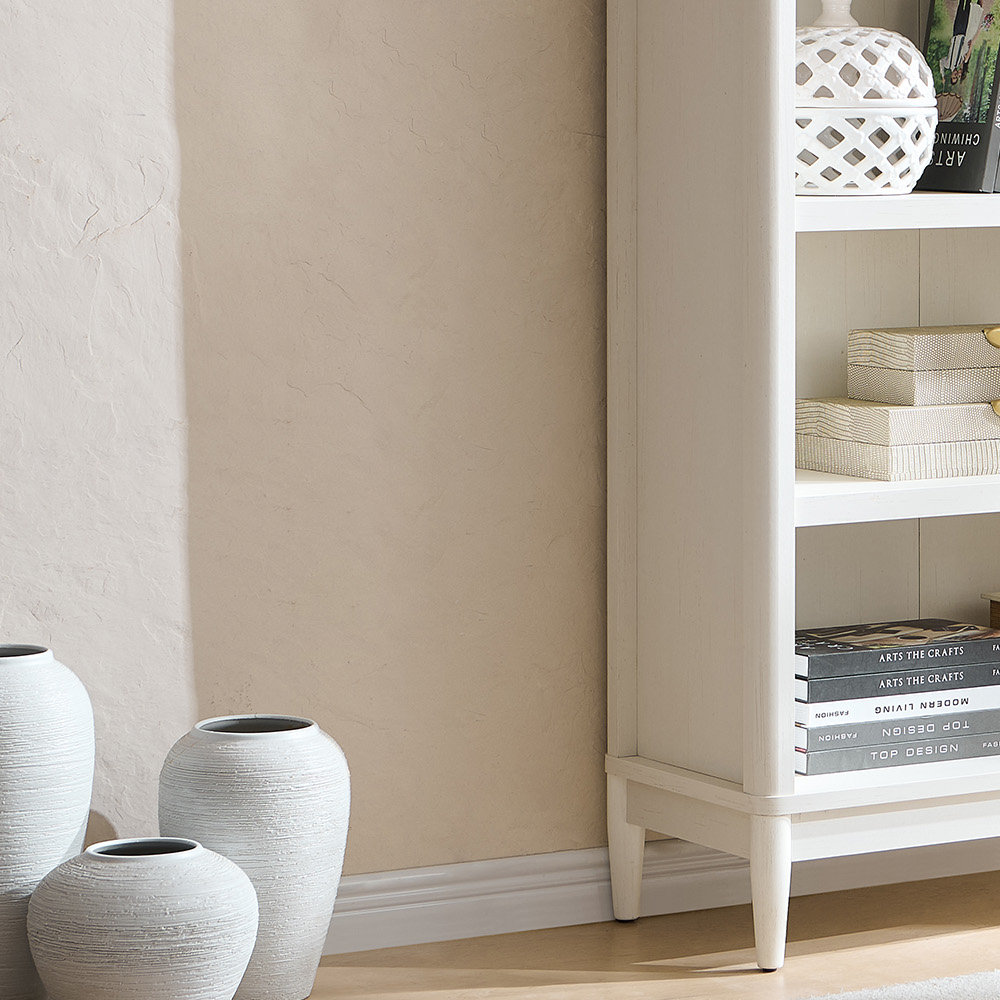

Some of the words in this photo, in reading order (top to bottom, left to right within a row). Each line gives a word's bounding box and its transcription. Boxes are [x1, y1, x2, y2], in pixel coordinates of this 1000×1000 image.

[879, 651, 903, 663] ARTS
[906, 649, 925, 660] THE
[927, 646, 964, 657] CRAFTS
[879, 677, 903, 688] ARTS
[906, 675, 925, 685] THE
[927, 671, 964, 683] CRAFTS
[875, 703, 914, 714] LIVING
[920, 697, 969, 710] MODERN
[815, 710, 849, 719] FASHION
[882, 723, 935, 737] DESIGN
[942, 720, 969, 730] TOP
[818, 732, 858, 742] FASHION
[871, 750, 898, 761] TOP
[906, 744, 959, 757] DESIGN
